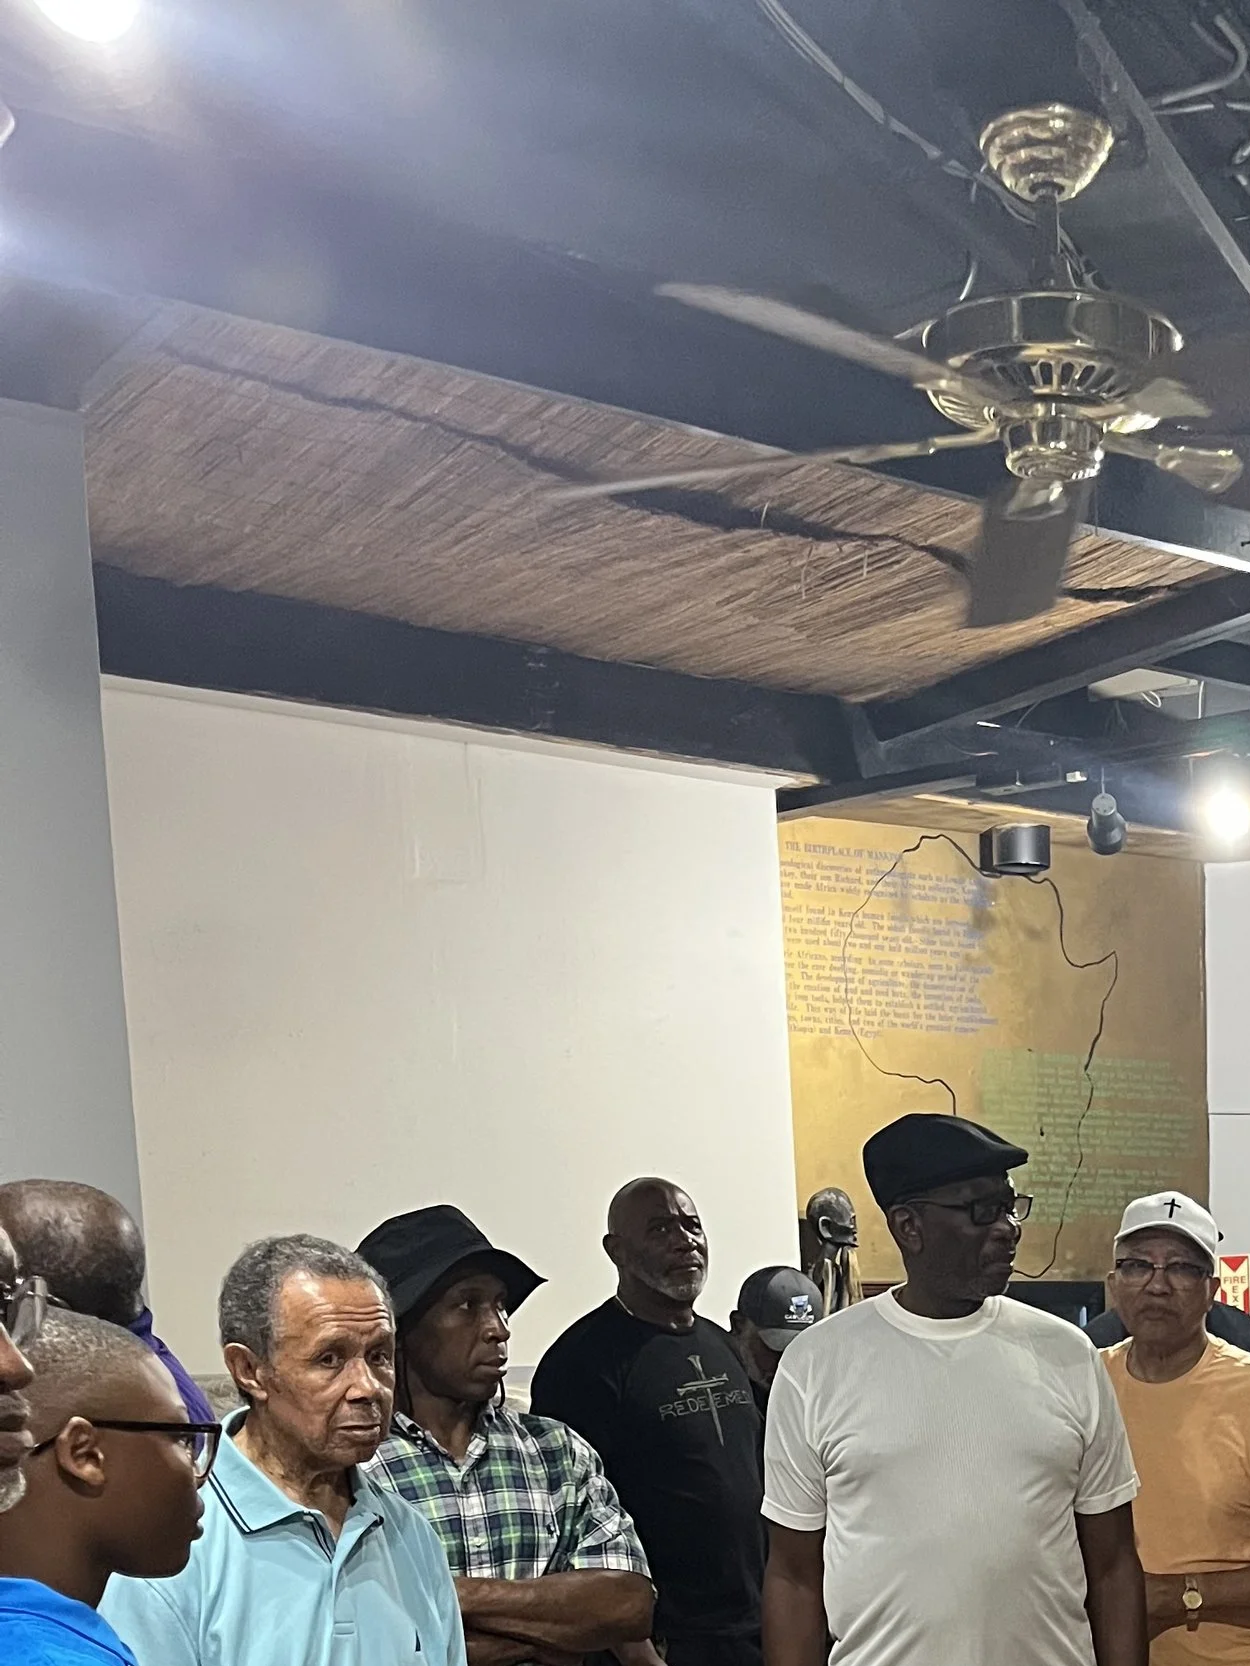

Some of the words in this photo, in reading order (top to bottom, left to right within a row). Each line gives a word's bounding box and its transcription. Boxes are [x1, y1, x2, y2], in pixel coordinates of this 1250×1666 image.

[785, 841, 801, 852] THE
[804, 843, 851, 857] BIRTHPLACE
[1223, 1275, 1247, 1285] FIRE
